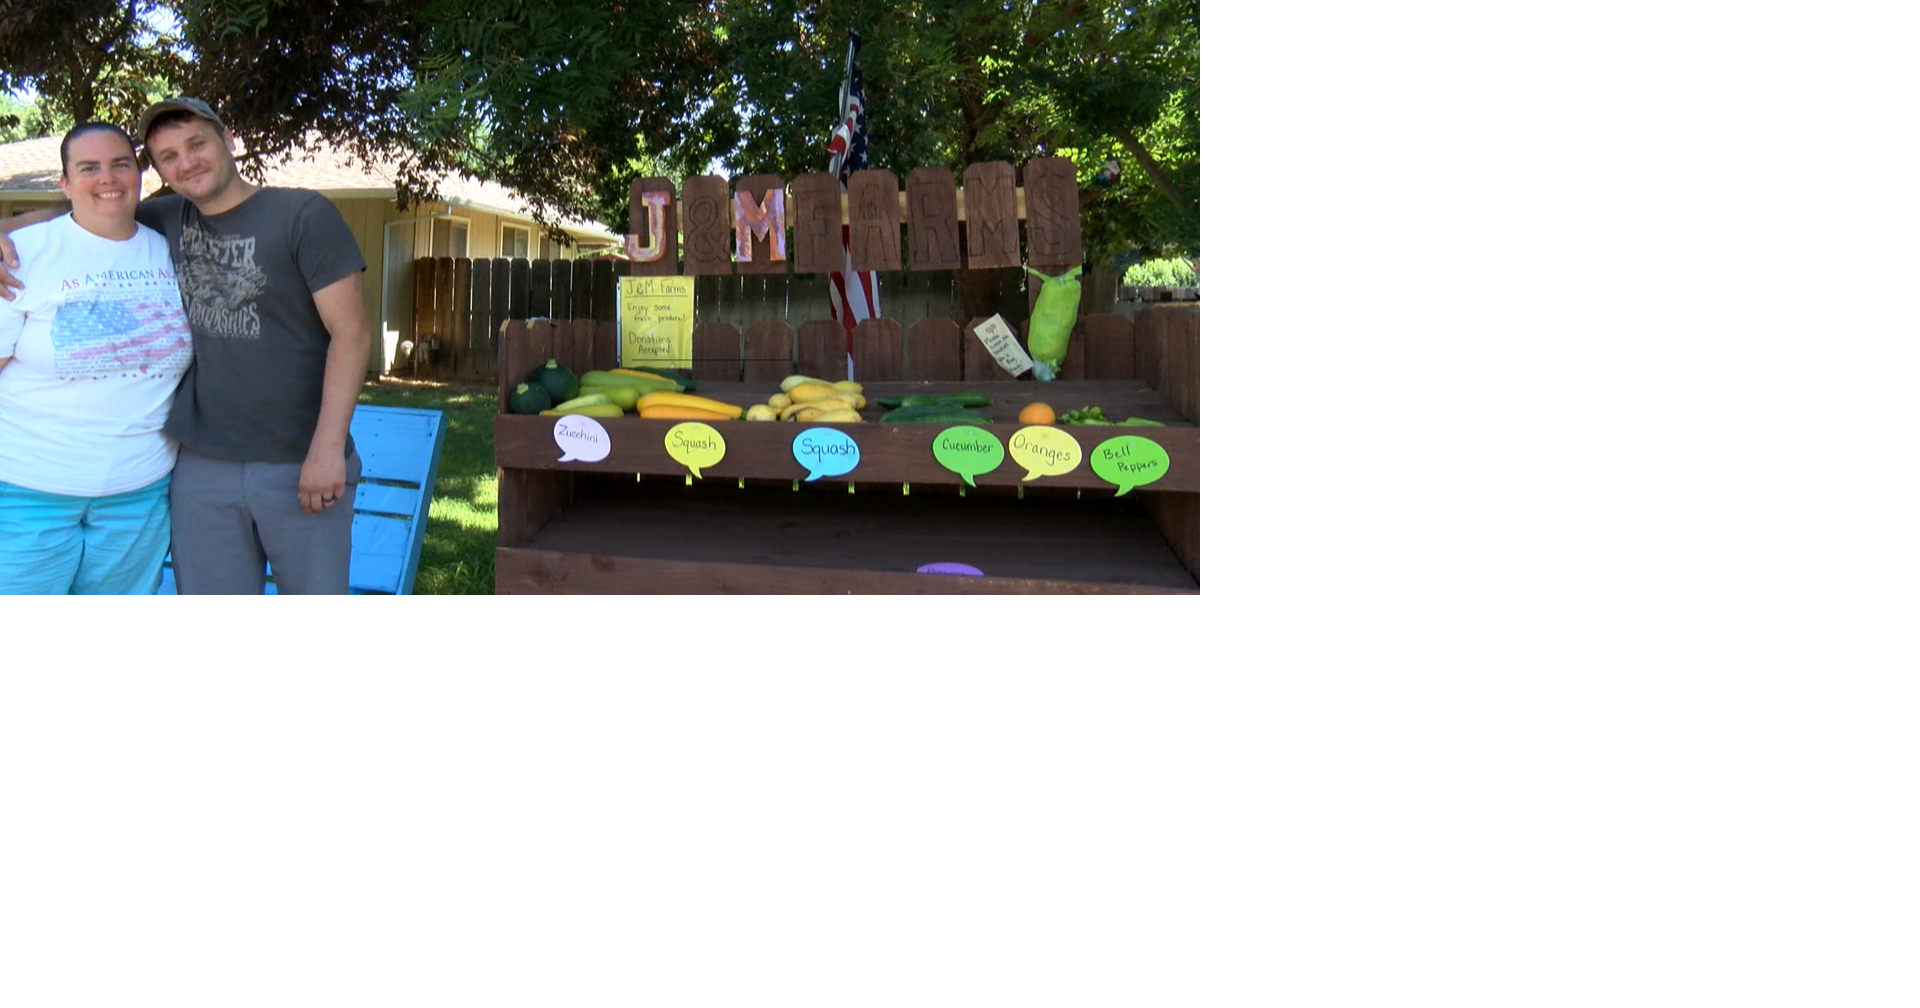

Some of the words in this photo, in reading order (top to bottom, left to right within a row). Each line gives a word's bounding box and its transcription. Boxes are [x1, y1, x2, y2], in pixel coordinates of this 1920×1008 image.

[795, 173, 1074, 268] FARMS
[85, 269, 155, 285] AMERICAN
[661, 278, 687, 294] Farms
[627, 302, 648, 315] Enjoy
[634, 314, 652, 322] fresh
[629, 331, 671, 345] Donations
[638, 344, 671, 356] Accepted
[558, 423, 599, 444] Zucchini
[671, 430, 717, 454] Squash
[801, 438, 856, 462] Squash
[942, 438, 994, 454] Cucumber
[1013, 434, 1071, 466] Oranges
[1103, 445, 1131, 460] Bell
[1117, 459, 1158, 473] Peppers
